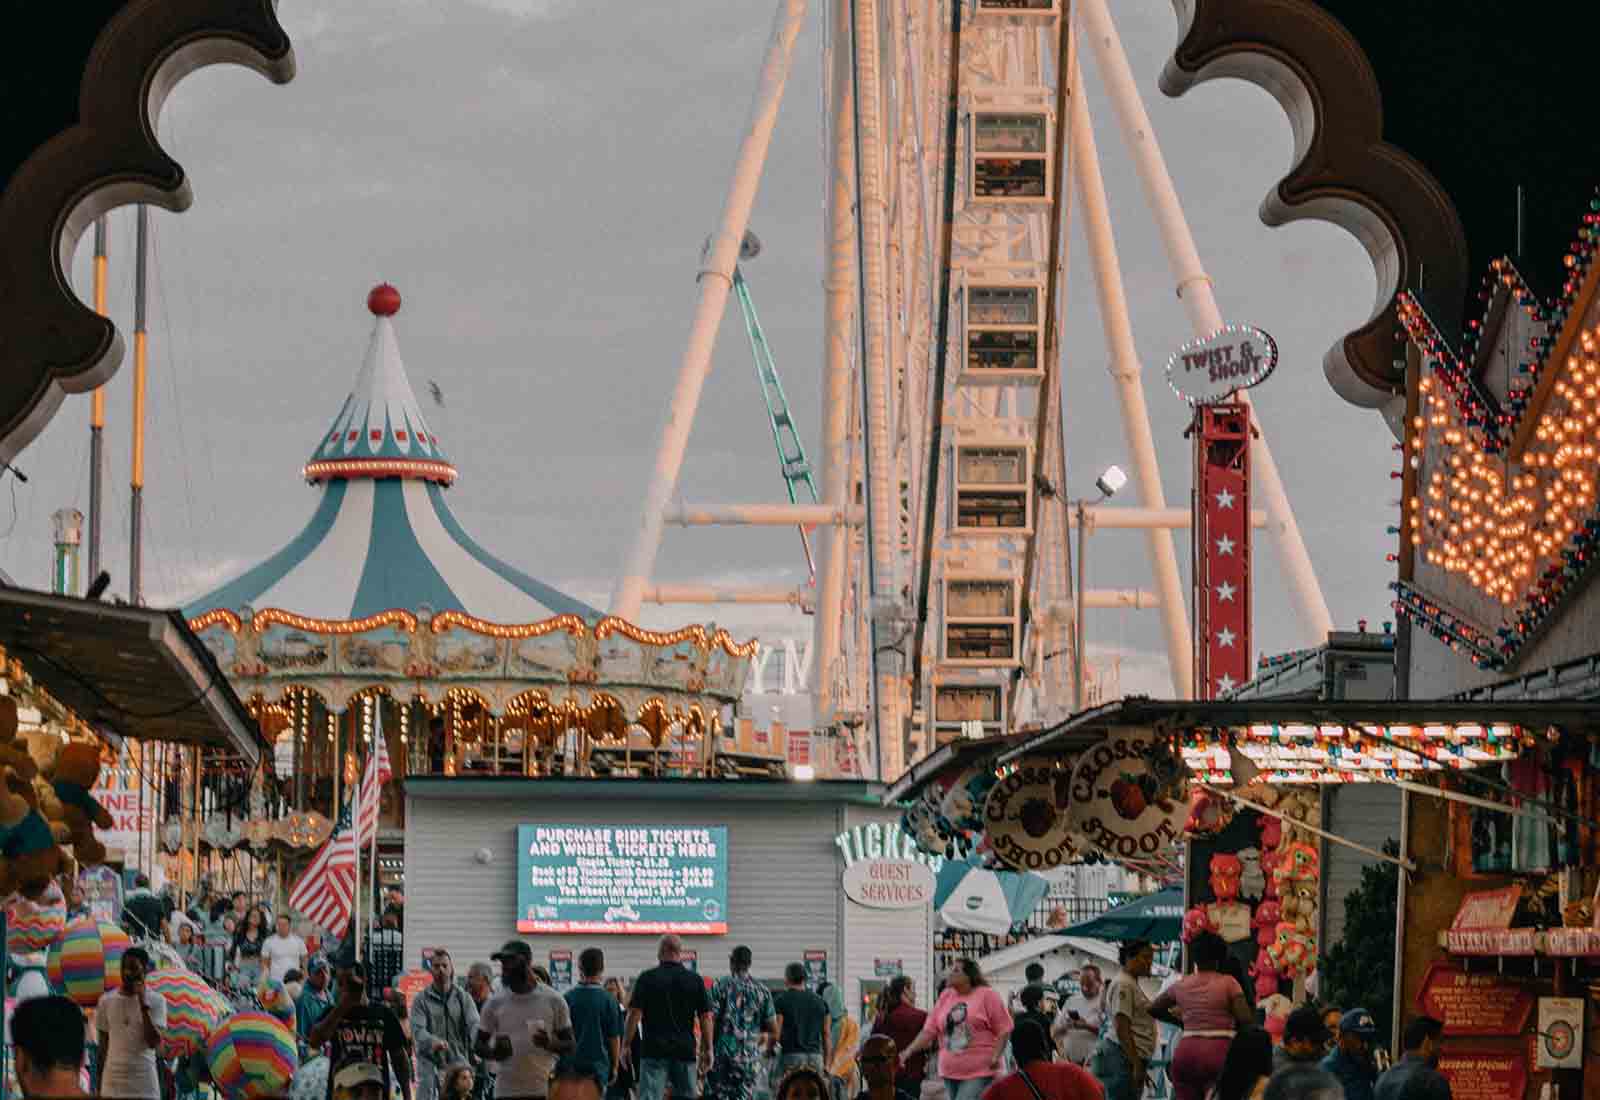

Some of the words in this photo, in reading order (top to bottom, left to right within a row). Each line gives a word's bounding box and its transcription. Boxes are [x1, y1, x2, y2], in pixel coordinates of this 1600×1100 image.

[1181, 345, 1233, 373] TWIST
[1209, 356, 1261, 382] SHOUT
[536, 829, 612, 842] PURCHASE
[615, 830, 650, 843] RIDE
[651, 830, 710, 844] TICKETS
[995, 821, 1075, 868] SHOOT
[1082, 818, 1176, 857] SHOOT
[529, 843, 560, 856] AND
[562, 843, 613, 857] WHEEL
[616, 843, 675, 857] TICKETS
[678, 844, 716, 857] HERE
[870, 864, 912, 880] GUEST
[862, 884, 923, 902] SERVICES
